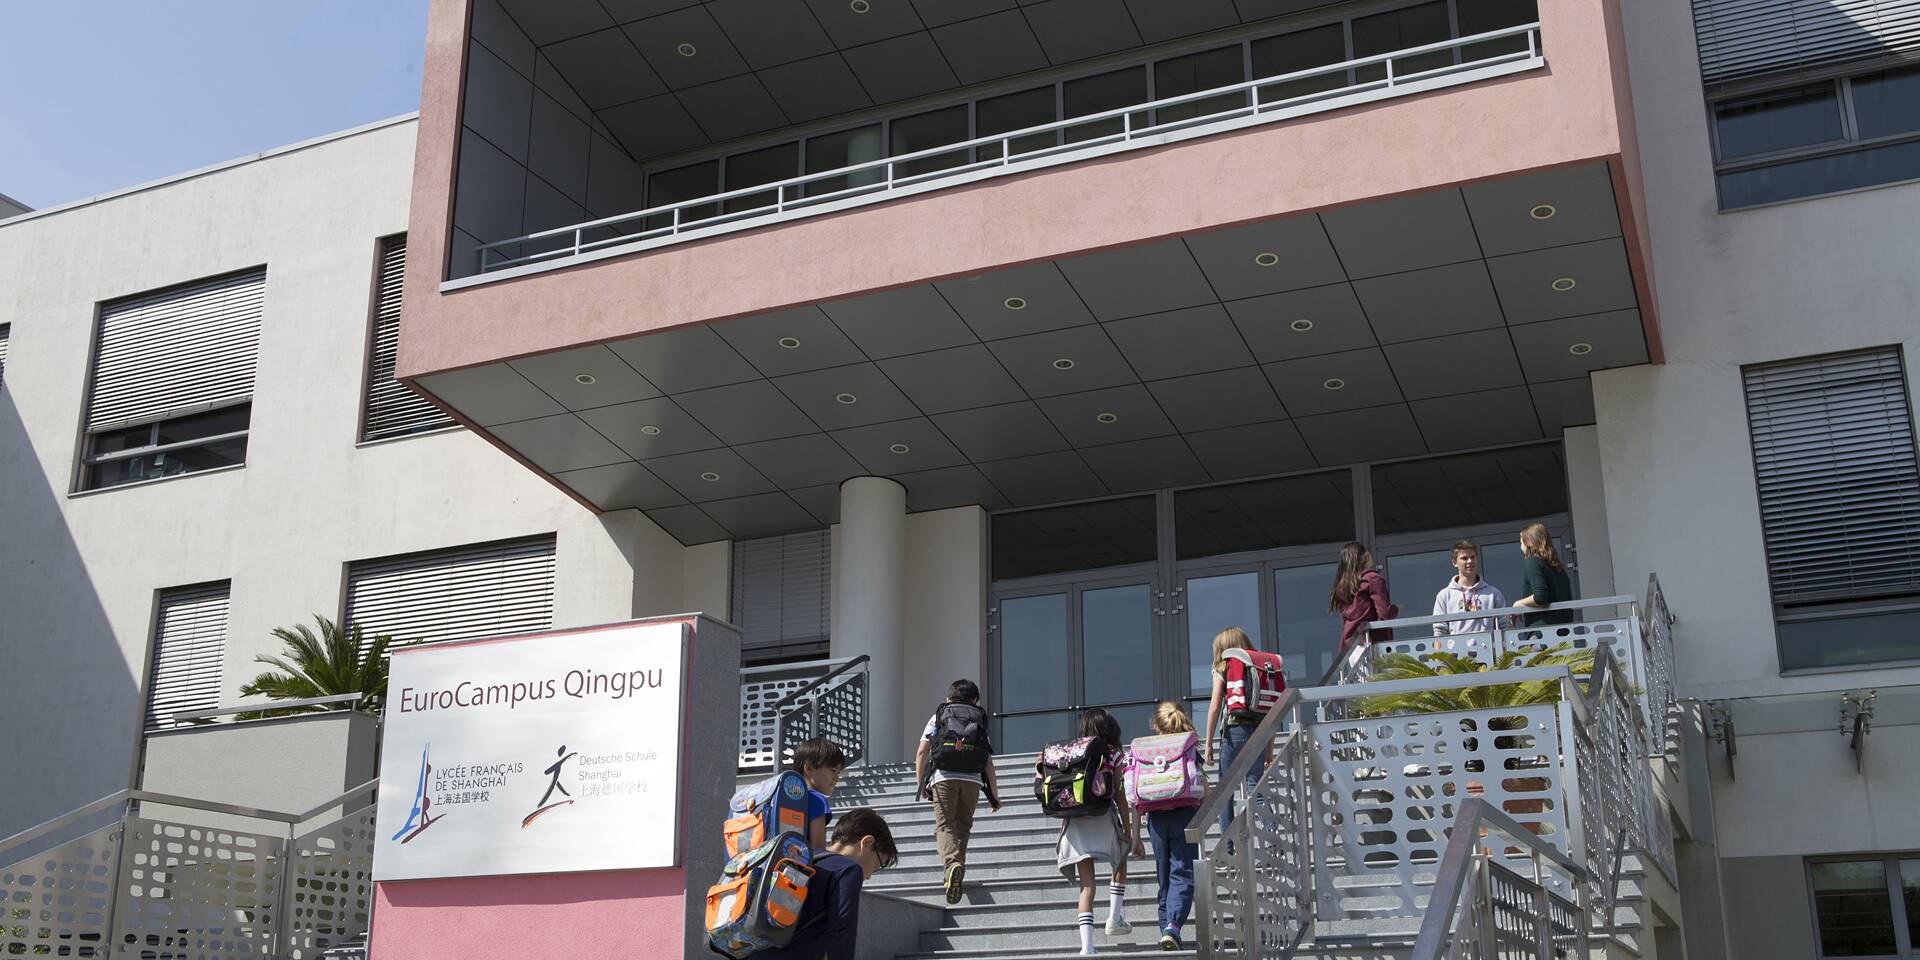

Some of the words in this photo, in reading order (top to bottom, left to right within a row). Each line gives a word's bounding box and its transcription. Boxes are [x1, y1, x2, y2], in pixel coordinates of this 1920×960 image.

[400, 680, 556, 713] EuroCampus
[564, 669, 662, 699] Qingpu
[579, 754, 622, 766] Deutsche
[625, 750, 657, 762] Schule
[436, 764, 466, 779] LYCÉE
[470, 762, 523, 776] FRANÇAIS
[578, 769, 621, 781] Shanghai
[435, 780, 447, 791] DE
[451, 776, 506, 790] SHANGHAI
[434, 790, 489, 805] 上海法国学校
